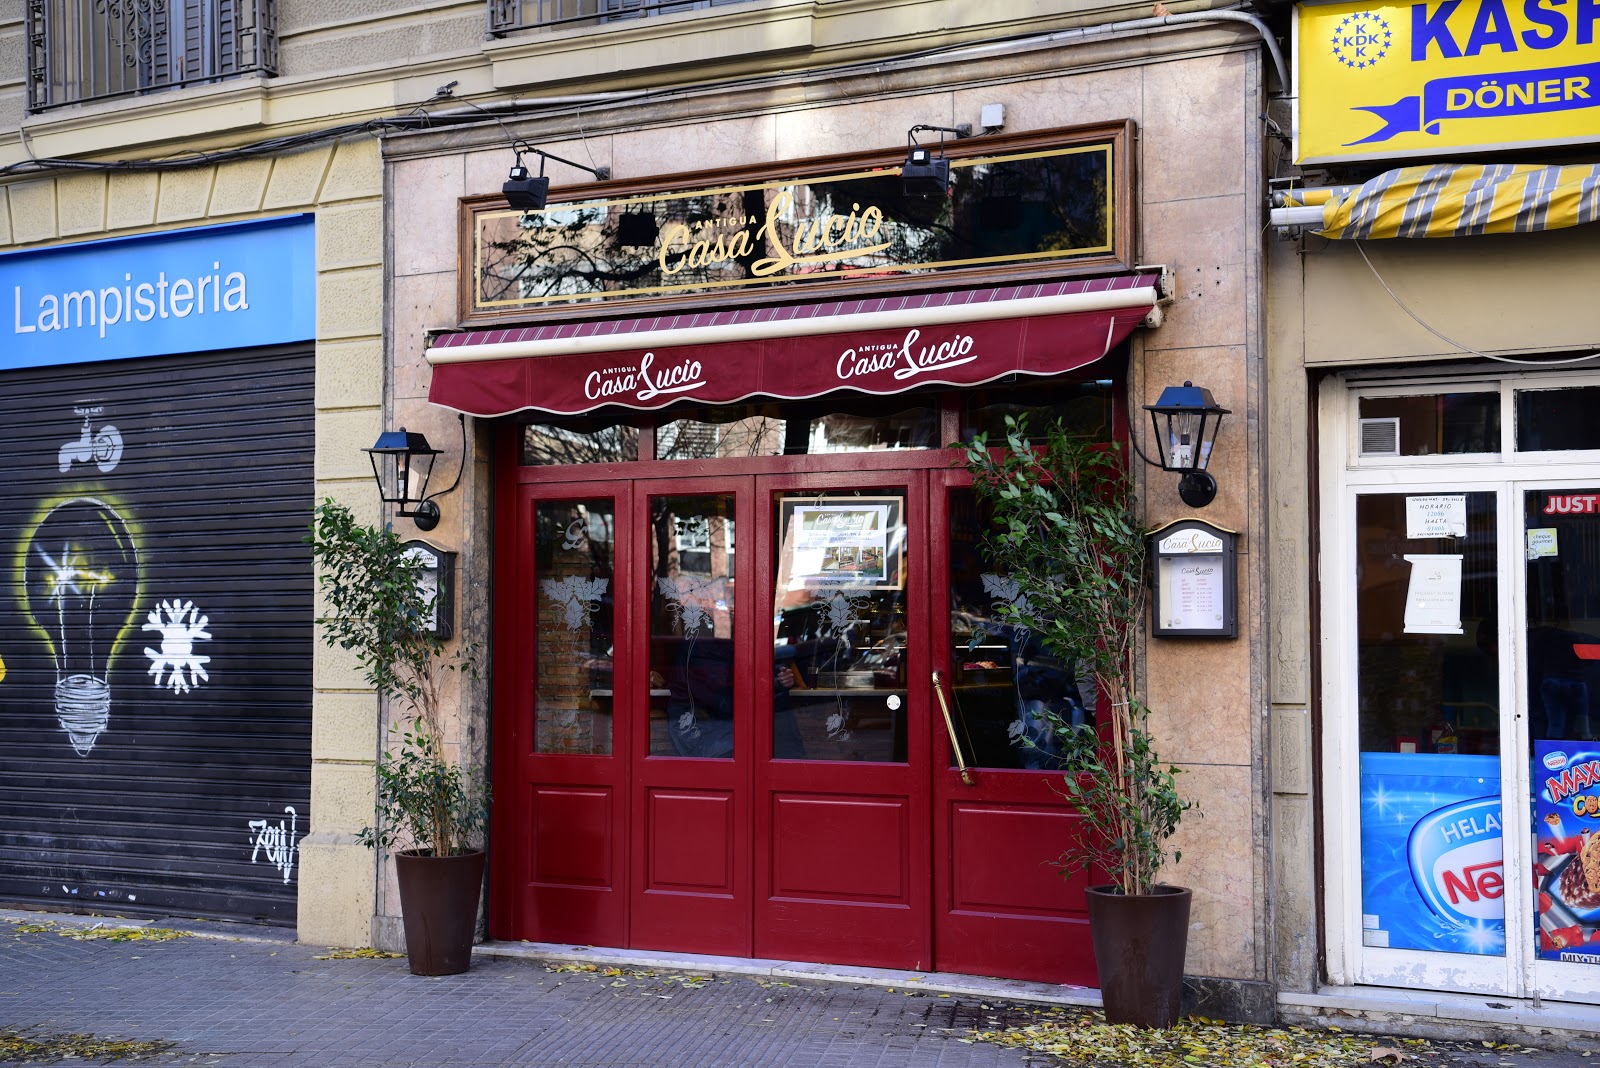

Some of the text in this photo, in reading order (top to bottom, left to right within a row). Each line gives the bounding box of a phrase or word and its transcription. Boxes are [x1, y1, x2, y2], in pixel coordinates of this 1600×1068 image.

[1446, 76, 1591, 111] DÖNER
[659, 191, 892, 276] Casa Lucio
[695, 215, 757, 230] ANTIGUA
[14, 261, 249, 338] Lampisteria
[836, 329, 978, 380] Casa Lucio
[858, 343, 898, 352] ANTIGUA
[584, 352, 707, 401] Casa Lucio
[602, 366, 637, 375] ANTIGUA
[1545, 496, 1597, 513] JUST
[1163, 533, 1223, 553] Casa Lucio
[1545, 760, 1600, 805] MAX
[1573, 795, 1600, 817] CO
[1440, 811, 1502, 845] HELA
